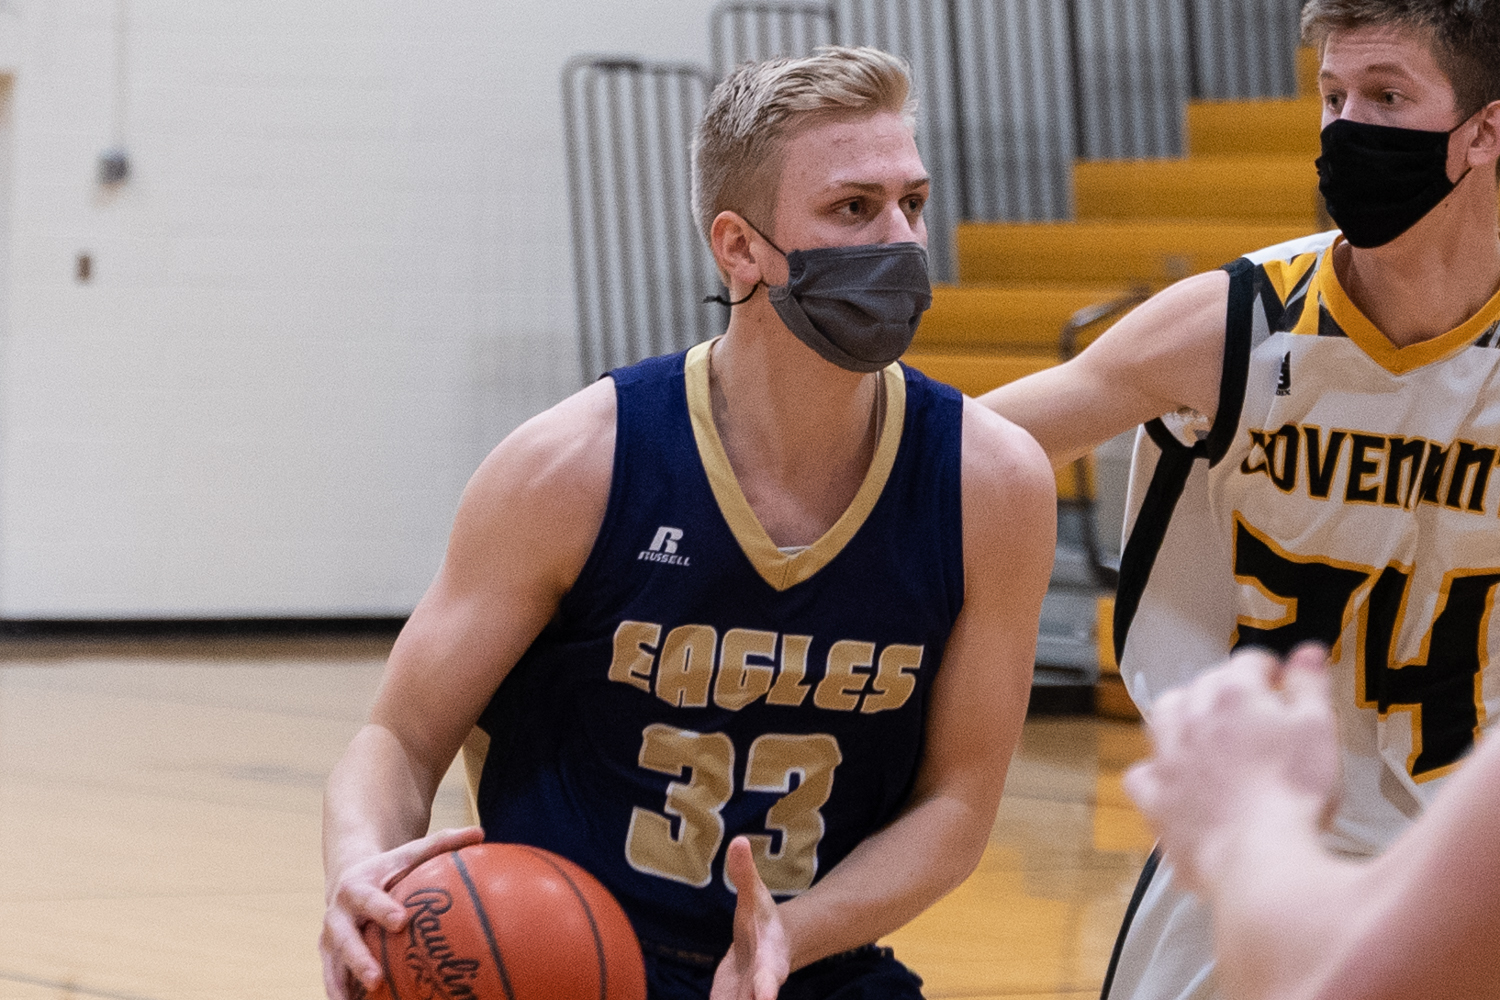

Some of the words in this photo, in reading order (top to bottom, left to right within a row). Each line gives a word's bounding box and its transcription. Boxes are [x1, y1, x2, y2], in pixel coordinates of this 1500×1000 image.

[637, 550, 690, 567] RUSSELL
[608, 620, 925, 714] EAGLES
[625, 723, 843, 897] 33
